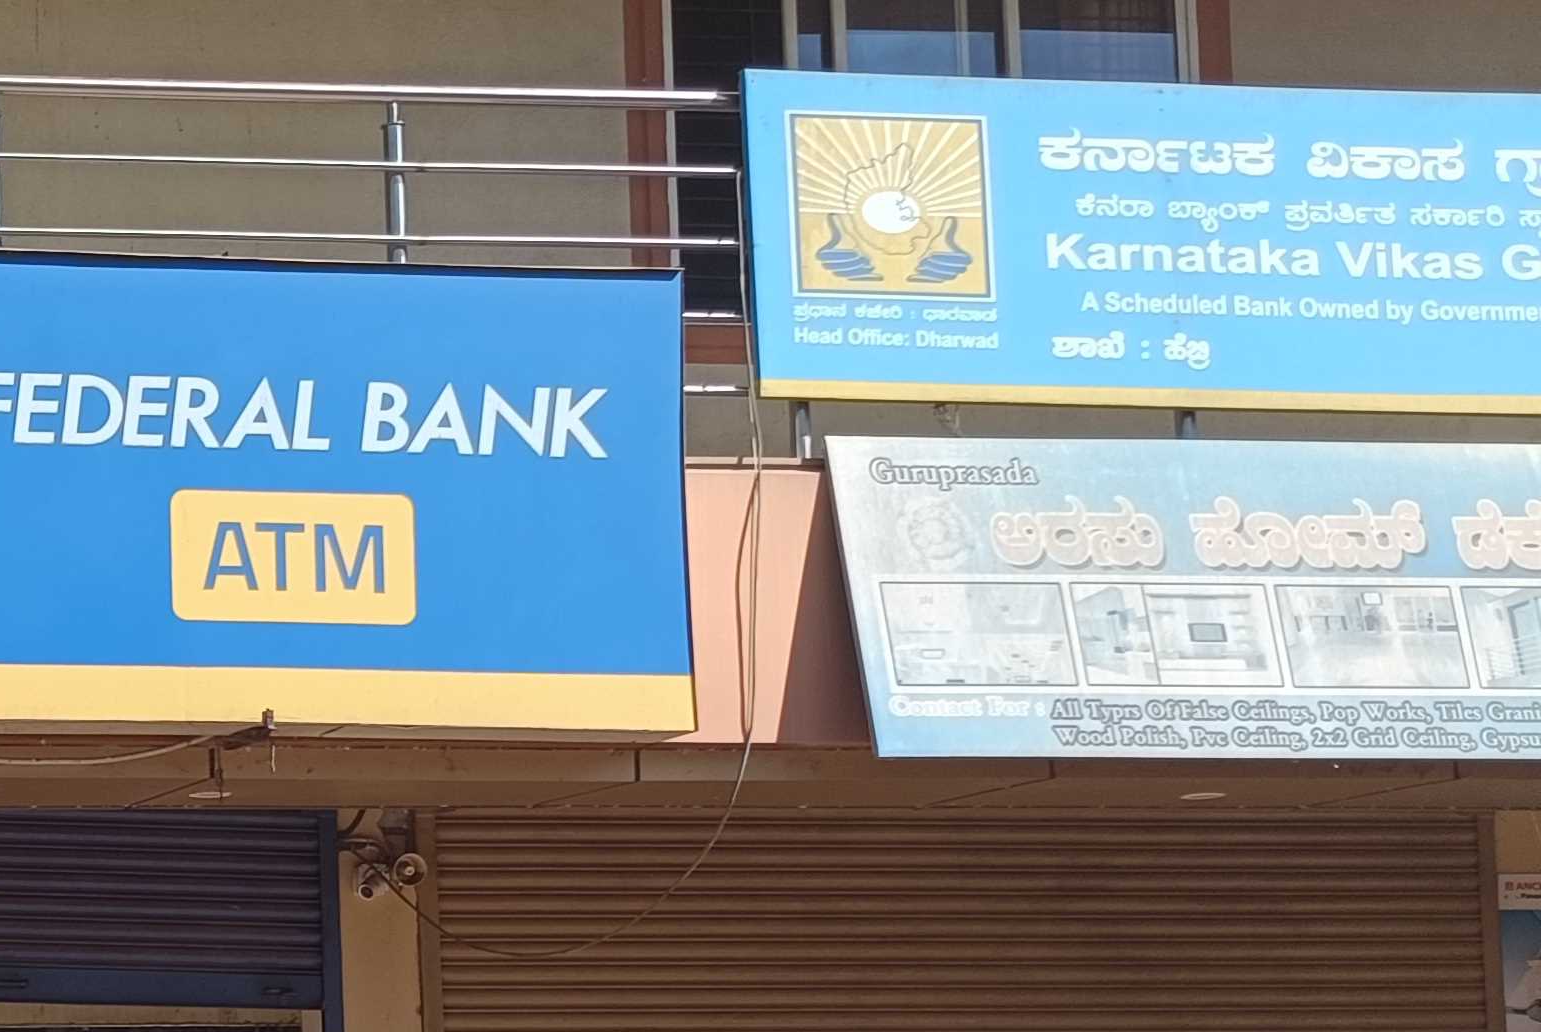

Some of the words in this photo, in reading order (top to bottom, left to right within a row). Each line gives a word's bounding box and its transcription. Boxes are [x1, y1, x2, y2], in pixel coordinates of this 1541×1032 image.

[1037, 126, 1276, 177] ಕರ್ನಾಟಕ
[1306, 138, 1465, 181] ವಿಕಾಸ
[1075, 193, 1154, 218] ಕೆನರಾ
[1167, 199, 1269, 232] ಬ್ಯಾಂಕ್
[1410, 202, 1505, 226] ಸರ್ಕಾರಿ
[1045, 233, 1321, 276] Karnataka
[1335, 241, 1483, 280] Vikas
[1081, 291, 1100, 311] A
[1105, 291, 1227, 316] Scheduled
[1234, 295, 1292, 318] Bank
[1299, 297, 1379, 321] Owned
[1385, 300, 1413, 325] by
[793, 327, 843, 345] Head
[848, 328, 910, 347] Office:
[916, 330, 999, 349] Dharwad
[1051, 333, 1125, 362] ಶಾಖೆ
[1163, 336, 1212, 371] ಹೆಬ್ರಿ
[360, 380, 606, 460] BANK
[990, 495, 1165, 568] ಅರಸು
[1191, 495, 1427, 570] ಹೋಮ್
[201, 519, 389, 594] ATM
[1050, 699, 1082, 720] All
[1145, 699, 1181, 721] Of
[1179, 700, 1229, 721] False
[1232, 700, 1315, 724] Ceilings,
[1319, 701, 1360, 725] Pop
[1361, 701, 1433, 724] Works,
[1435, 702, 1482, 723] Tiles
[1053, 724, 1115, 747] Wood
[1118, 725, 1188, 749] Polish,
[1190, 726, 1228, 747] Pvc
[1231, 726, 1308, 751] Ceiling,
[1311, 727, 1347, 747] 2x2
[1351, 727, 1398, 748] Grid
[1401, 727, 1477, 751] Ceiling,
